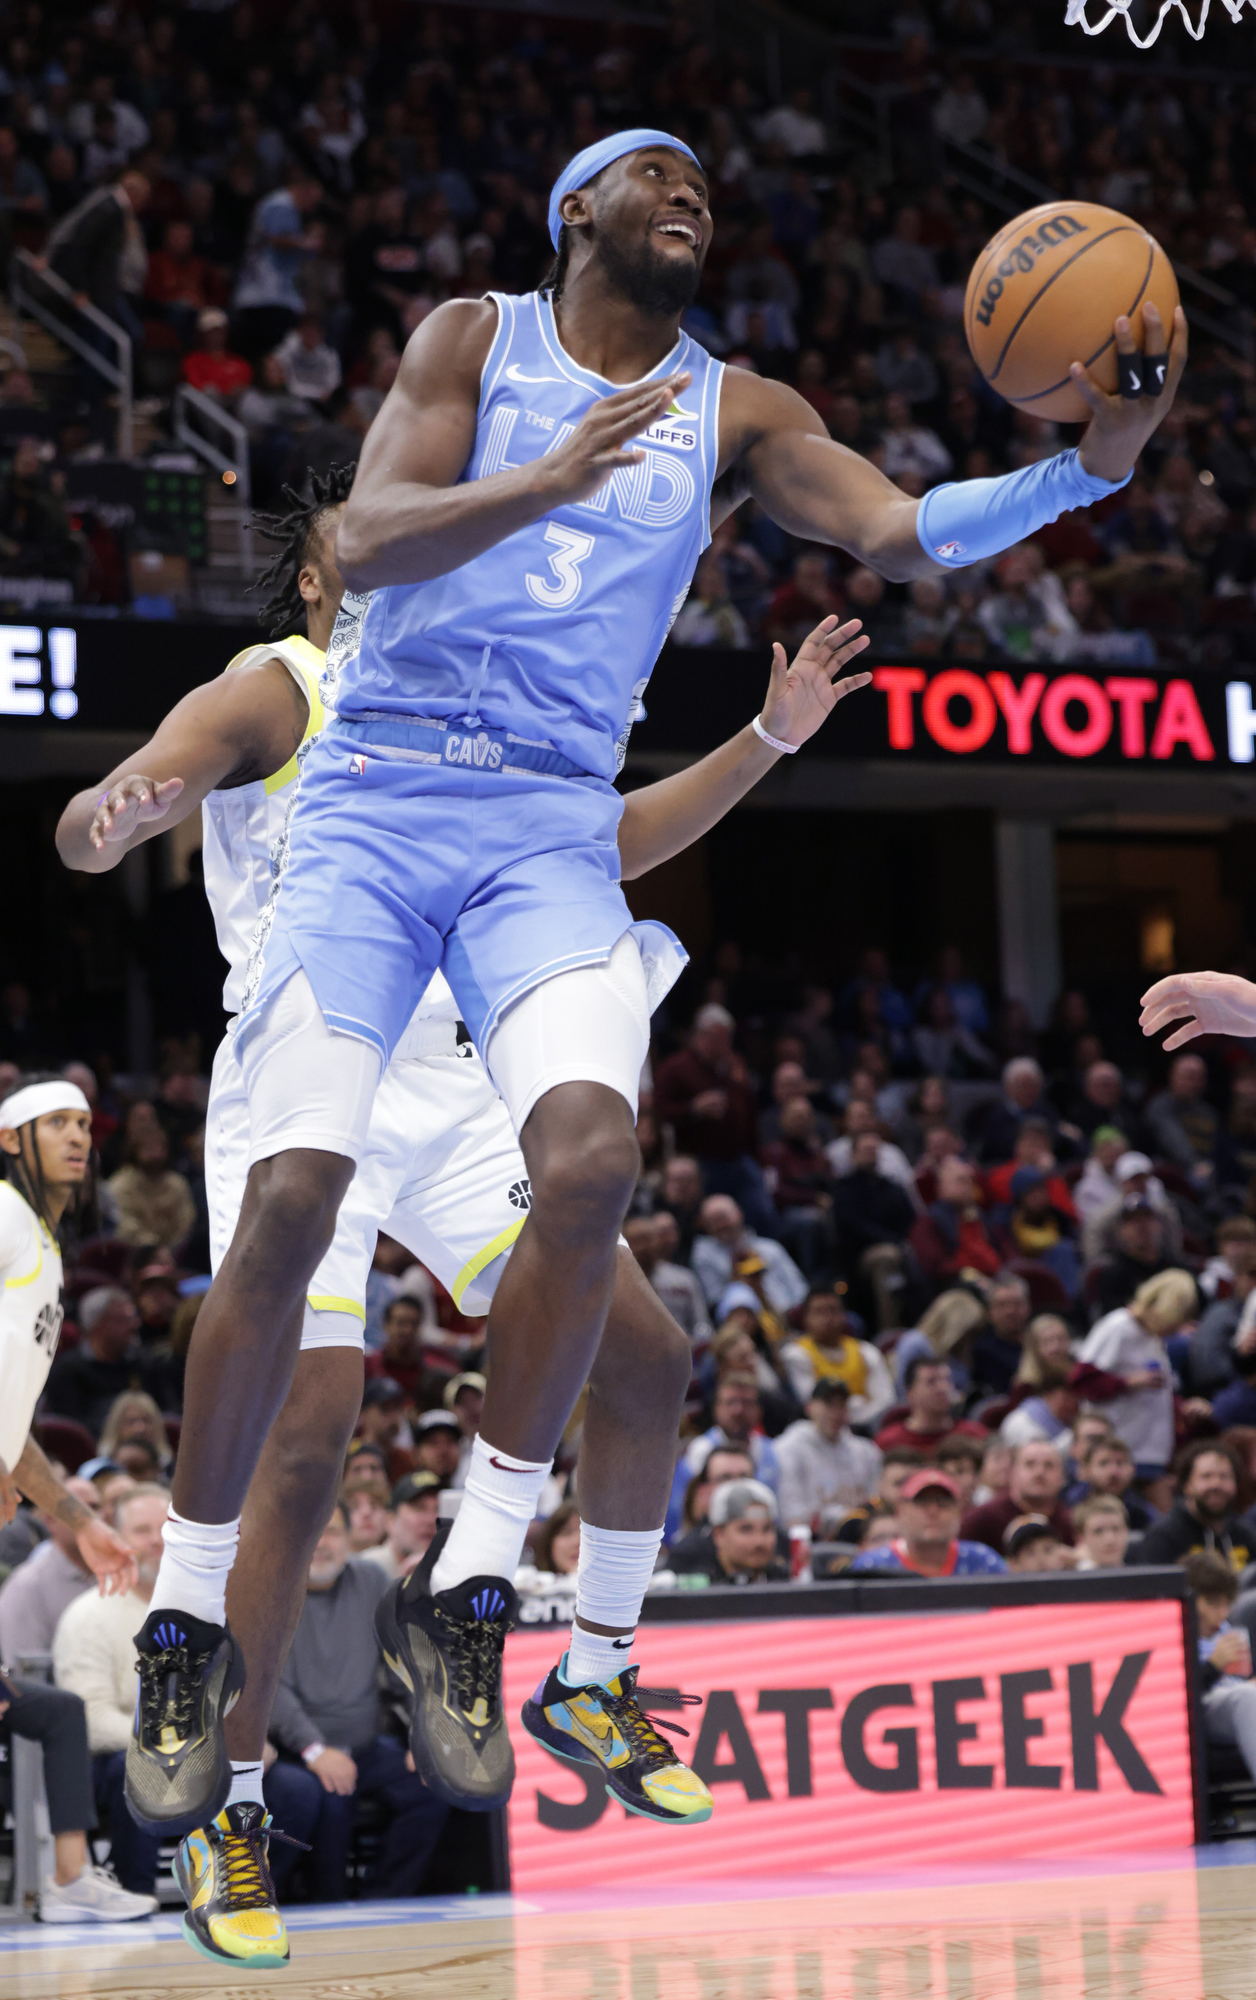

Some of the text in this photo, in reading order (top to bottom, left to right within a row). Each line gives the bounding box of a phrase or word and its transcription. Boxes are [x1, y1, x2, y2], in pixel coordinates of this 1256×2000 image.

[975, 215, 1090, 327] Wilson
[525, 410, 556, 431] THE
[645, 427, 695, 446] LIFFS
[525, 521, 596, 608] 3
[0, 625, 78, 719] E!
[872, 666, 1216, 761] TOYOTA
[445, 732, 503, 769] CAVS
[535, 1649, 1167, 1832] SATGEEK
